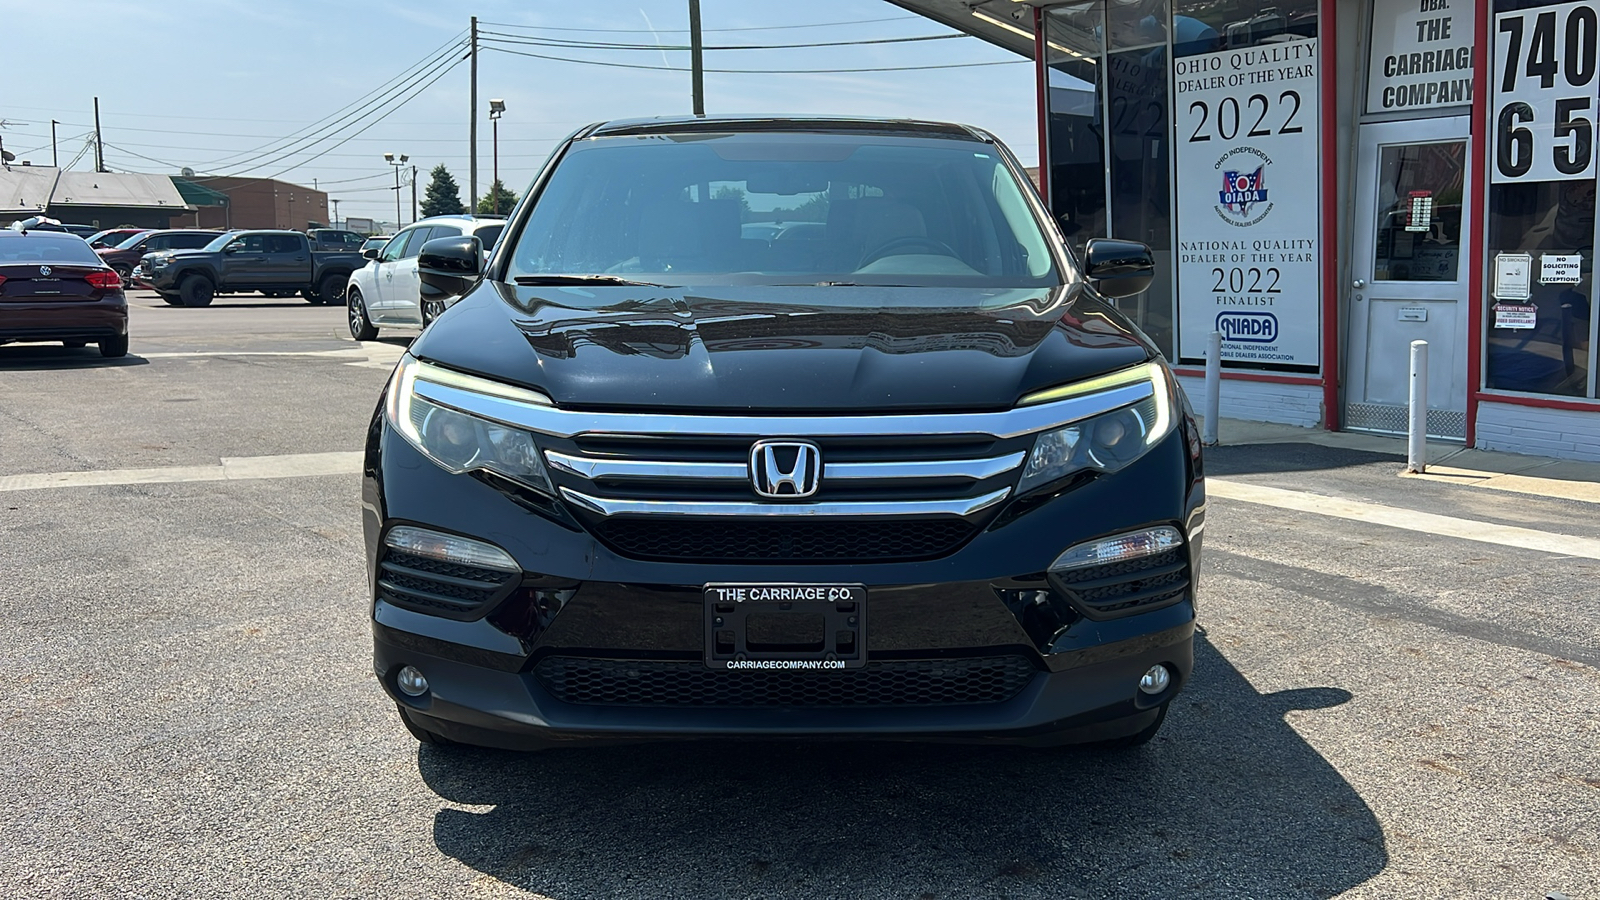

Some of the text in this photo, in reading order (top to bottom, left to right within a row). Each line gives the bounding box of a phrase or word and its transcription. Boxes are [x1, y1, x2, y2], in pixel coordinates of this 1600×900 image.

[1416, 17, 1452, 42] THE
[1176, 42, 1315, 75] OHIO QUALITY
[1500, 6, 1597, 92] 740
[1178, 76, 1226, 93] DEALER
[1229, 73, 1245, 87] OF
[1248, 70, 1274, 84] THE
[1278, 64, 1314, 80] YEAR
[1383, 78, 1474, 108] COMPANY
[1189, 90, 1303, 143] 2022
[1214, 147, 1273, 169] OHIO INDEPENDENT
[1225, 191, 1260, 203] OIADA
[1214, 205, 1234, 226] AUTOMOBILE
[1252, 202, 1274, 225] ASSOCIATION
[1181, 240, 1314, 251] NATIONAL QUALITY
[1182, 253, 1312, 263] DEALER OF THE YEAR
[1212, 267, 1281, 293] 2022
[1216, 296, 1275, 306] FINALIST
[1221, 318, 1272, 337] NIADA
[717, 588, 854, 601] THE CARRIAGE CO.
[726, 660, 845, 670] CARRIAGECOMPANY.COM
